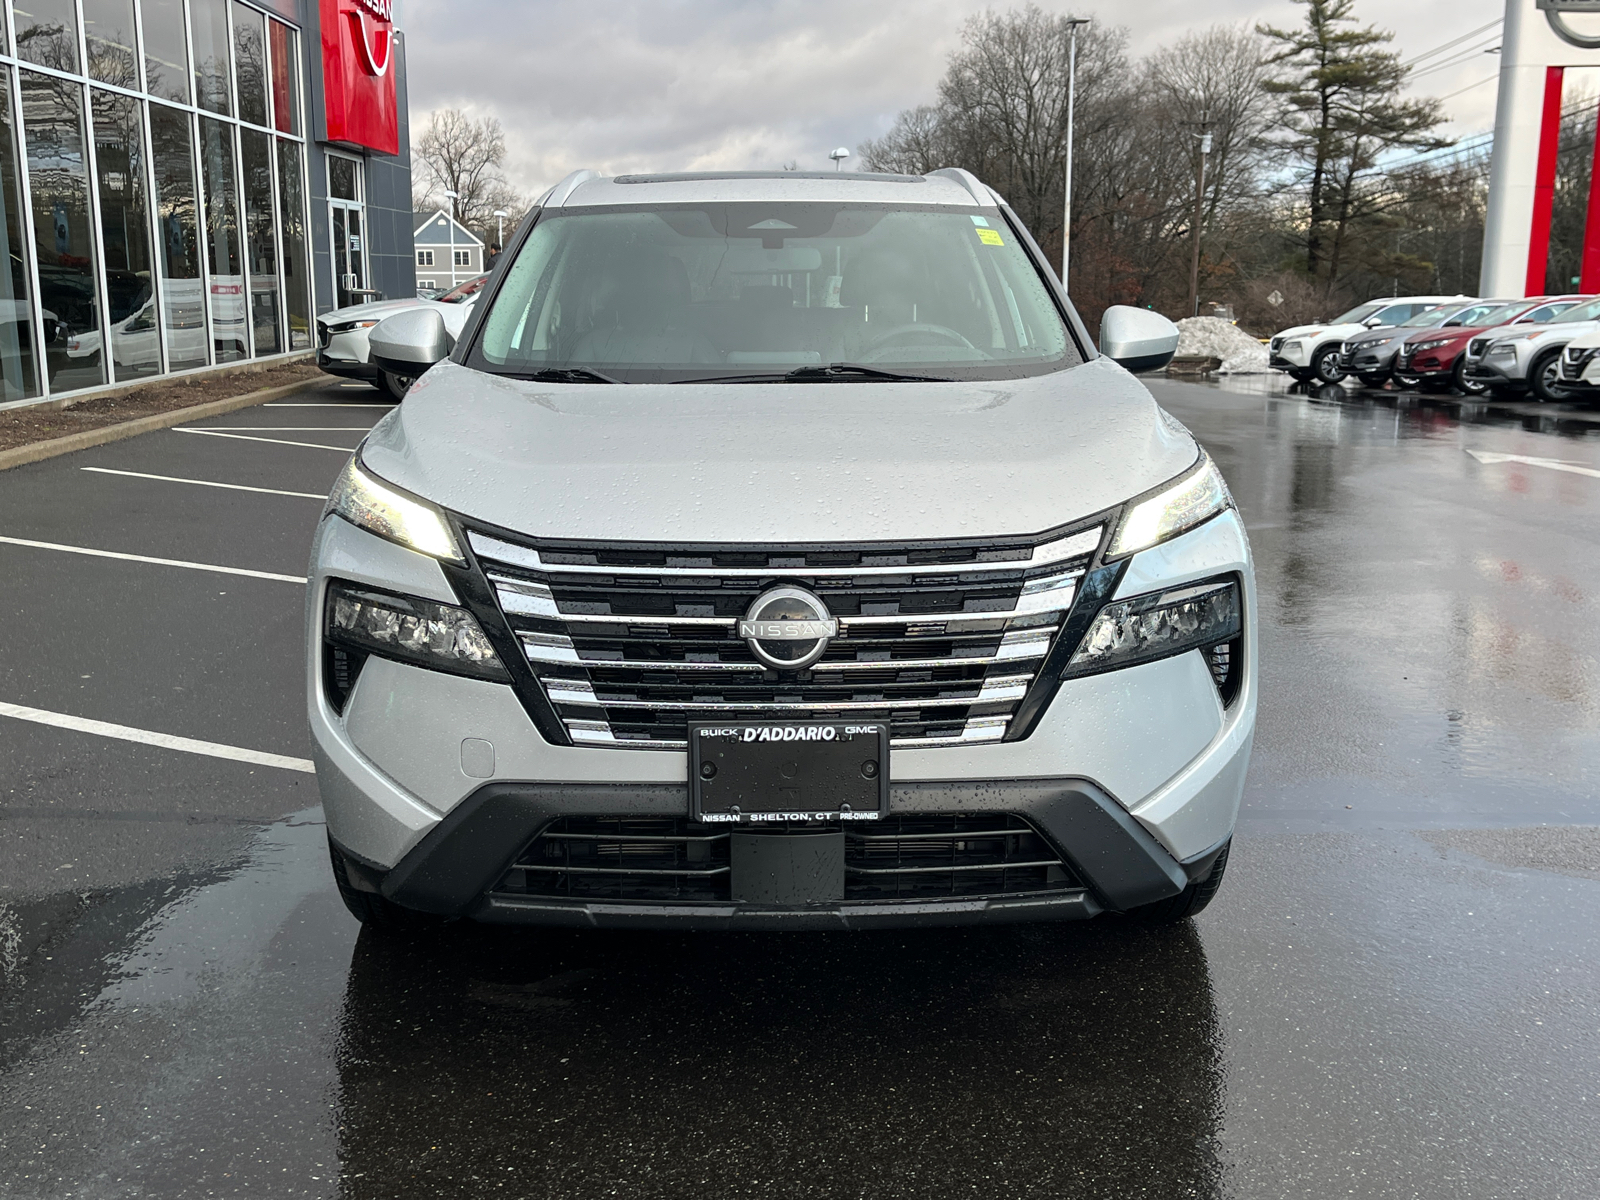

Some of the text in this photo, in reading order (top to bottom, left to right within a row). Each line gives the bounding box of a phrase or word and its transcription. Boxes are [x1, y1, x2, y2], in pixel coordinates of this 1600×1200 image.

[741, 624, 833, 636] NISSAN
[700, 725, 878, 742] BUICK D'ADDARIO GMC
[702, 812, 879, 822] NISSAN SHELTON, CT PRE-OWNED
